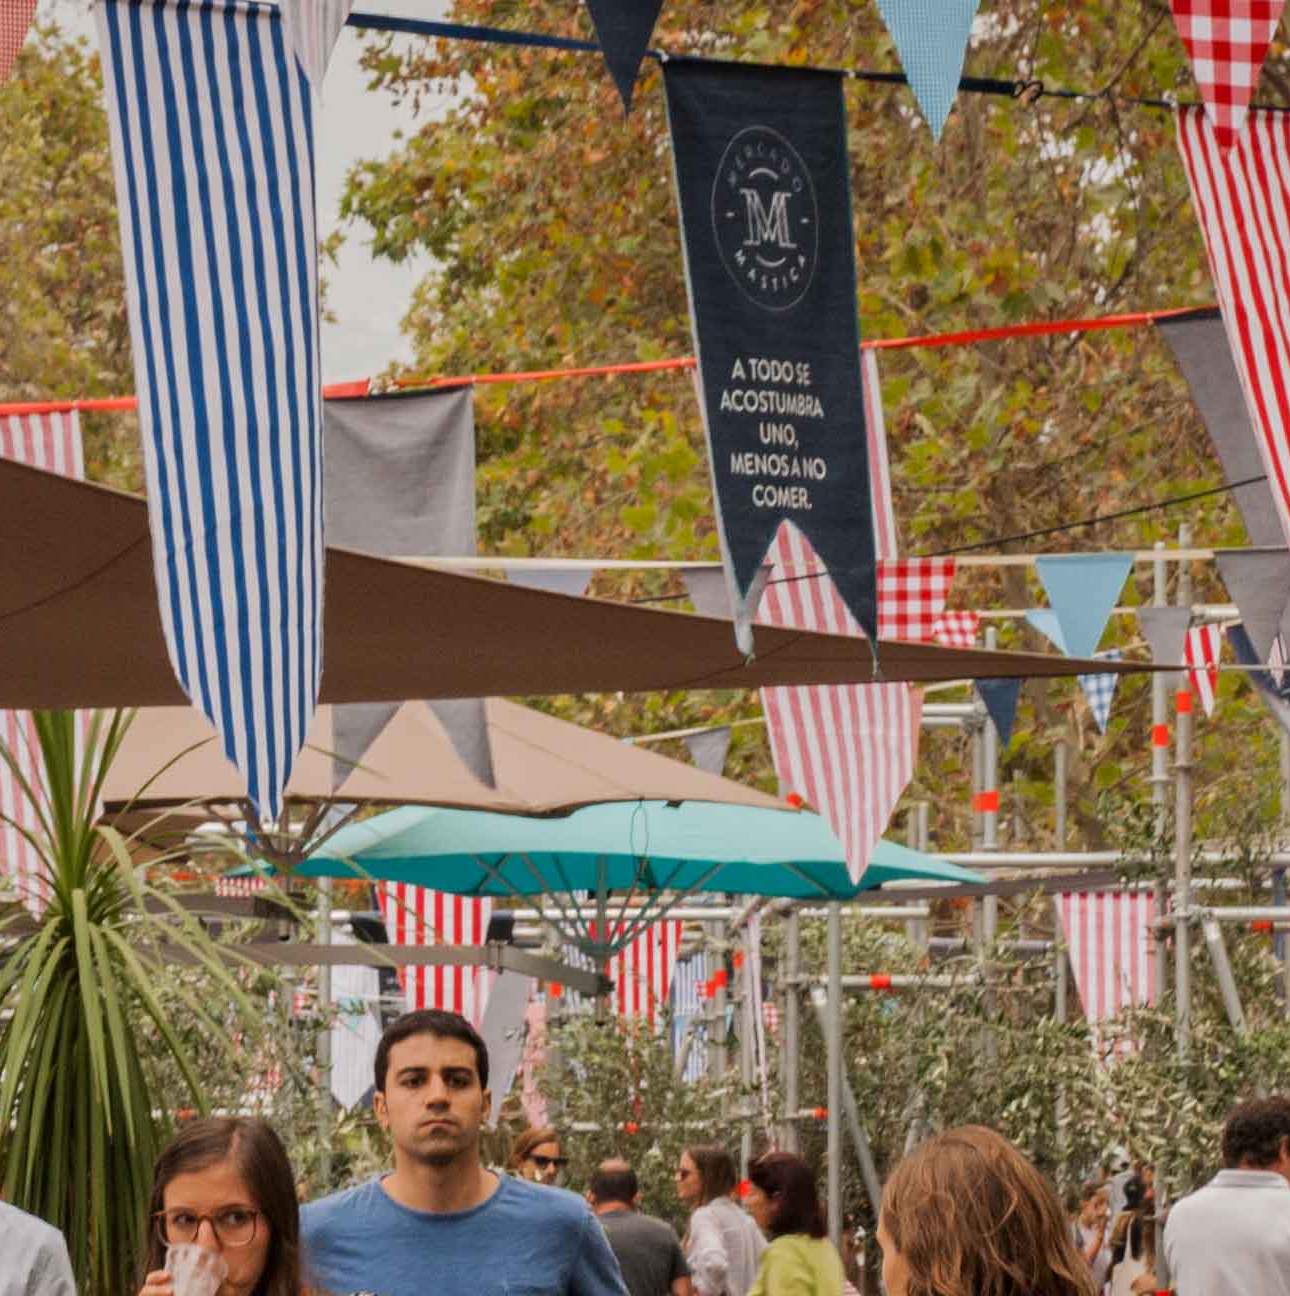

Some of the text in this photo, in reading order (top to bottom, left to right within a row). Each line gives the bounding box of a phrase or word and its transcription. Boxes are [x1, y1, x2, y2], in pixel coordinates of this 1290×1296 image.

[731, 357, 812, 386] A TODO SE
[720, 389, 825, 419] ACOSTUMBRA
[759, 423, 799, 451] UNO,
[730, 452, 827, 480] MENOS A NO
[752, 484, 813, 510] COMER.
